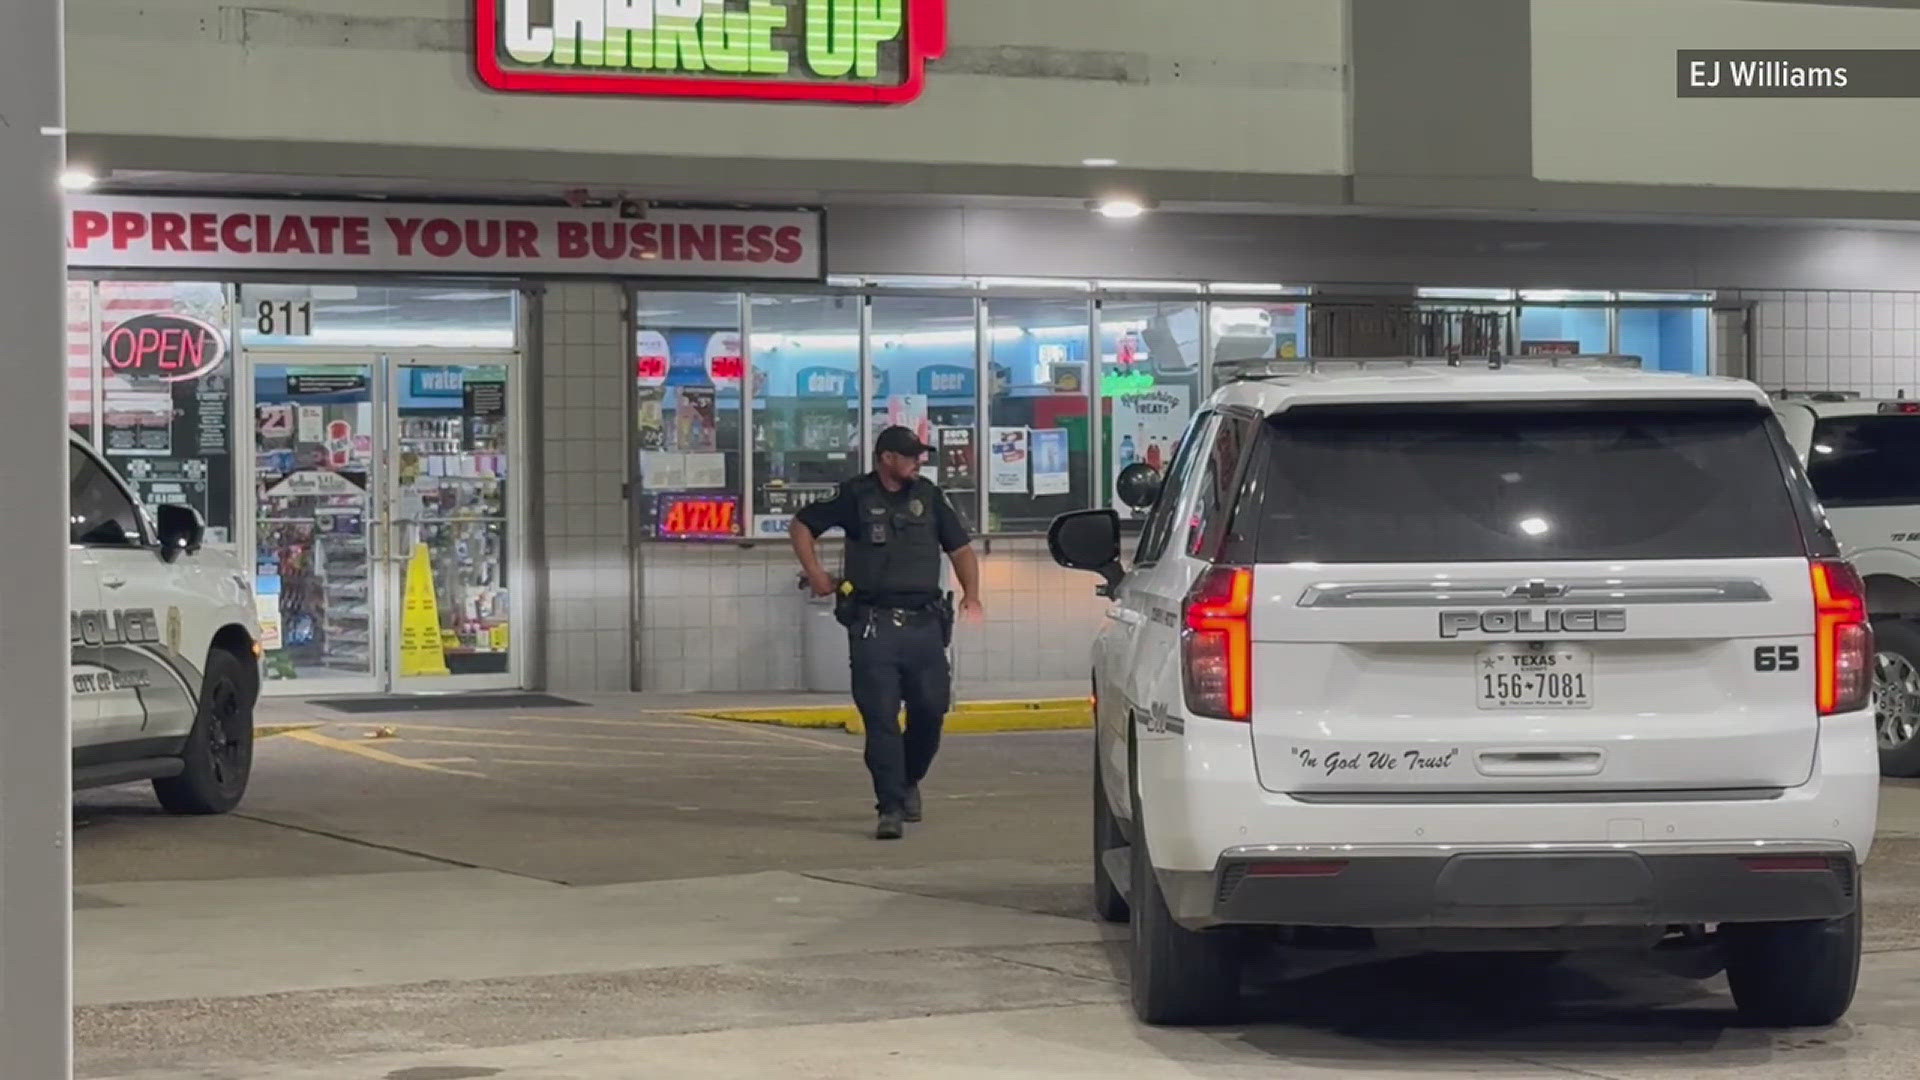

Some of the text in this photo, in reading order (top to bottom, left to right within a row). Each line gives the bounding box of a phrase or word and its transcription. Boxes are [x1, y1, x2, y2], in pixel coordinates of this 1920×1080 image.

[505, 0, 901, 77] CHARGE UP
[67, 211, 803, 263] PPRECIATE YOUR BUSINESS
[258, 301, 311, 336] 811
[109, 328, 205, 370] OPEN
[808, 371, 846, 393] dairy
[931, 370, 965, 391] beer
[1135, 404, 1169, 414] TREATS
[664, 501, 736, 534] ATM
[1439, 609, 1626, 638] POLICE
[1513, 655, 1557, 667] TEXAS
[1754, 646, 1799, 671] 65
[1324, 752, 1361, 776] God
[1367, 751, 1397, 769] We
